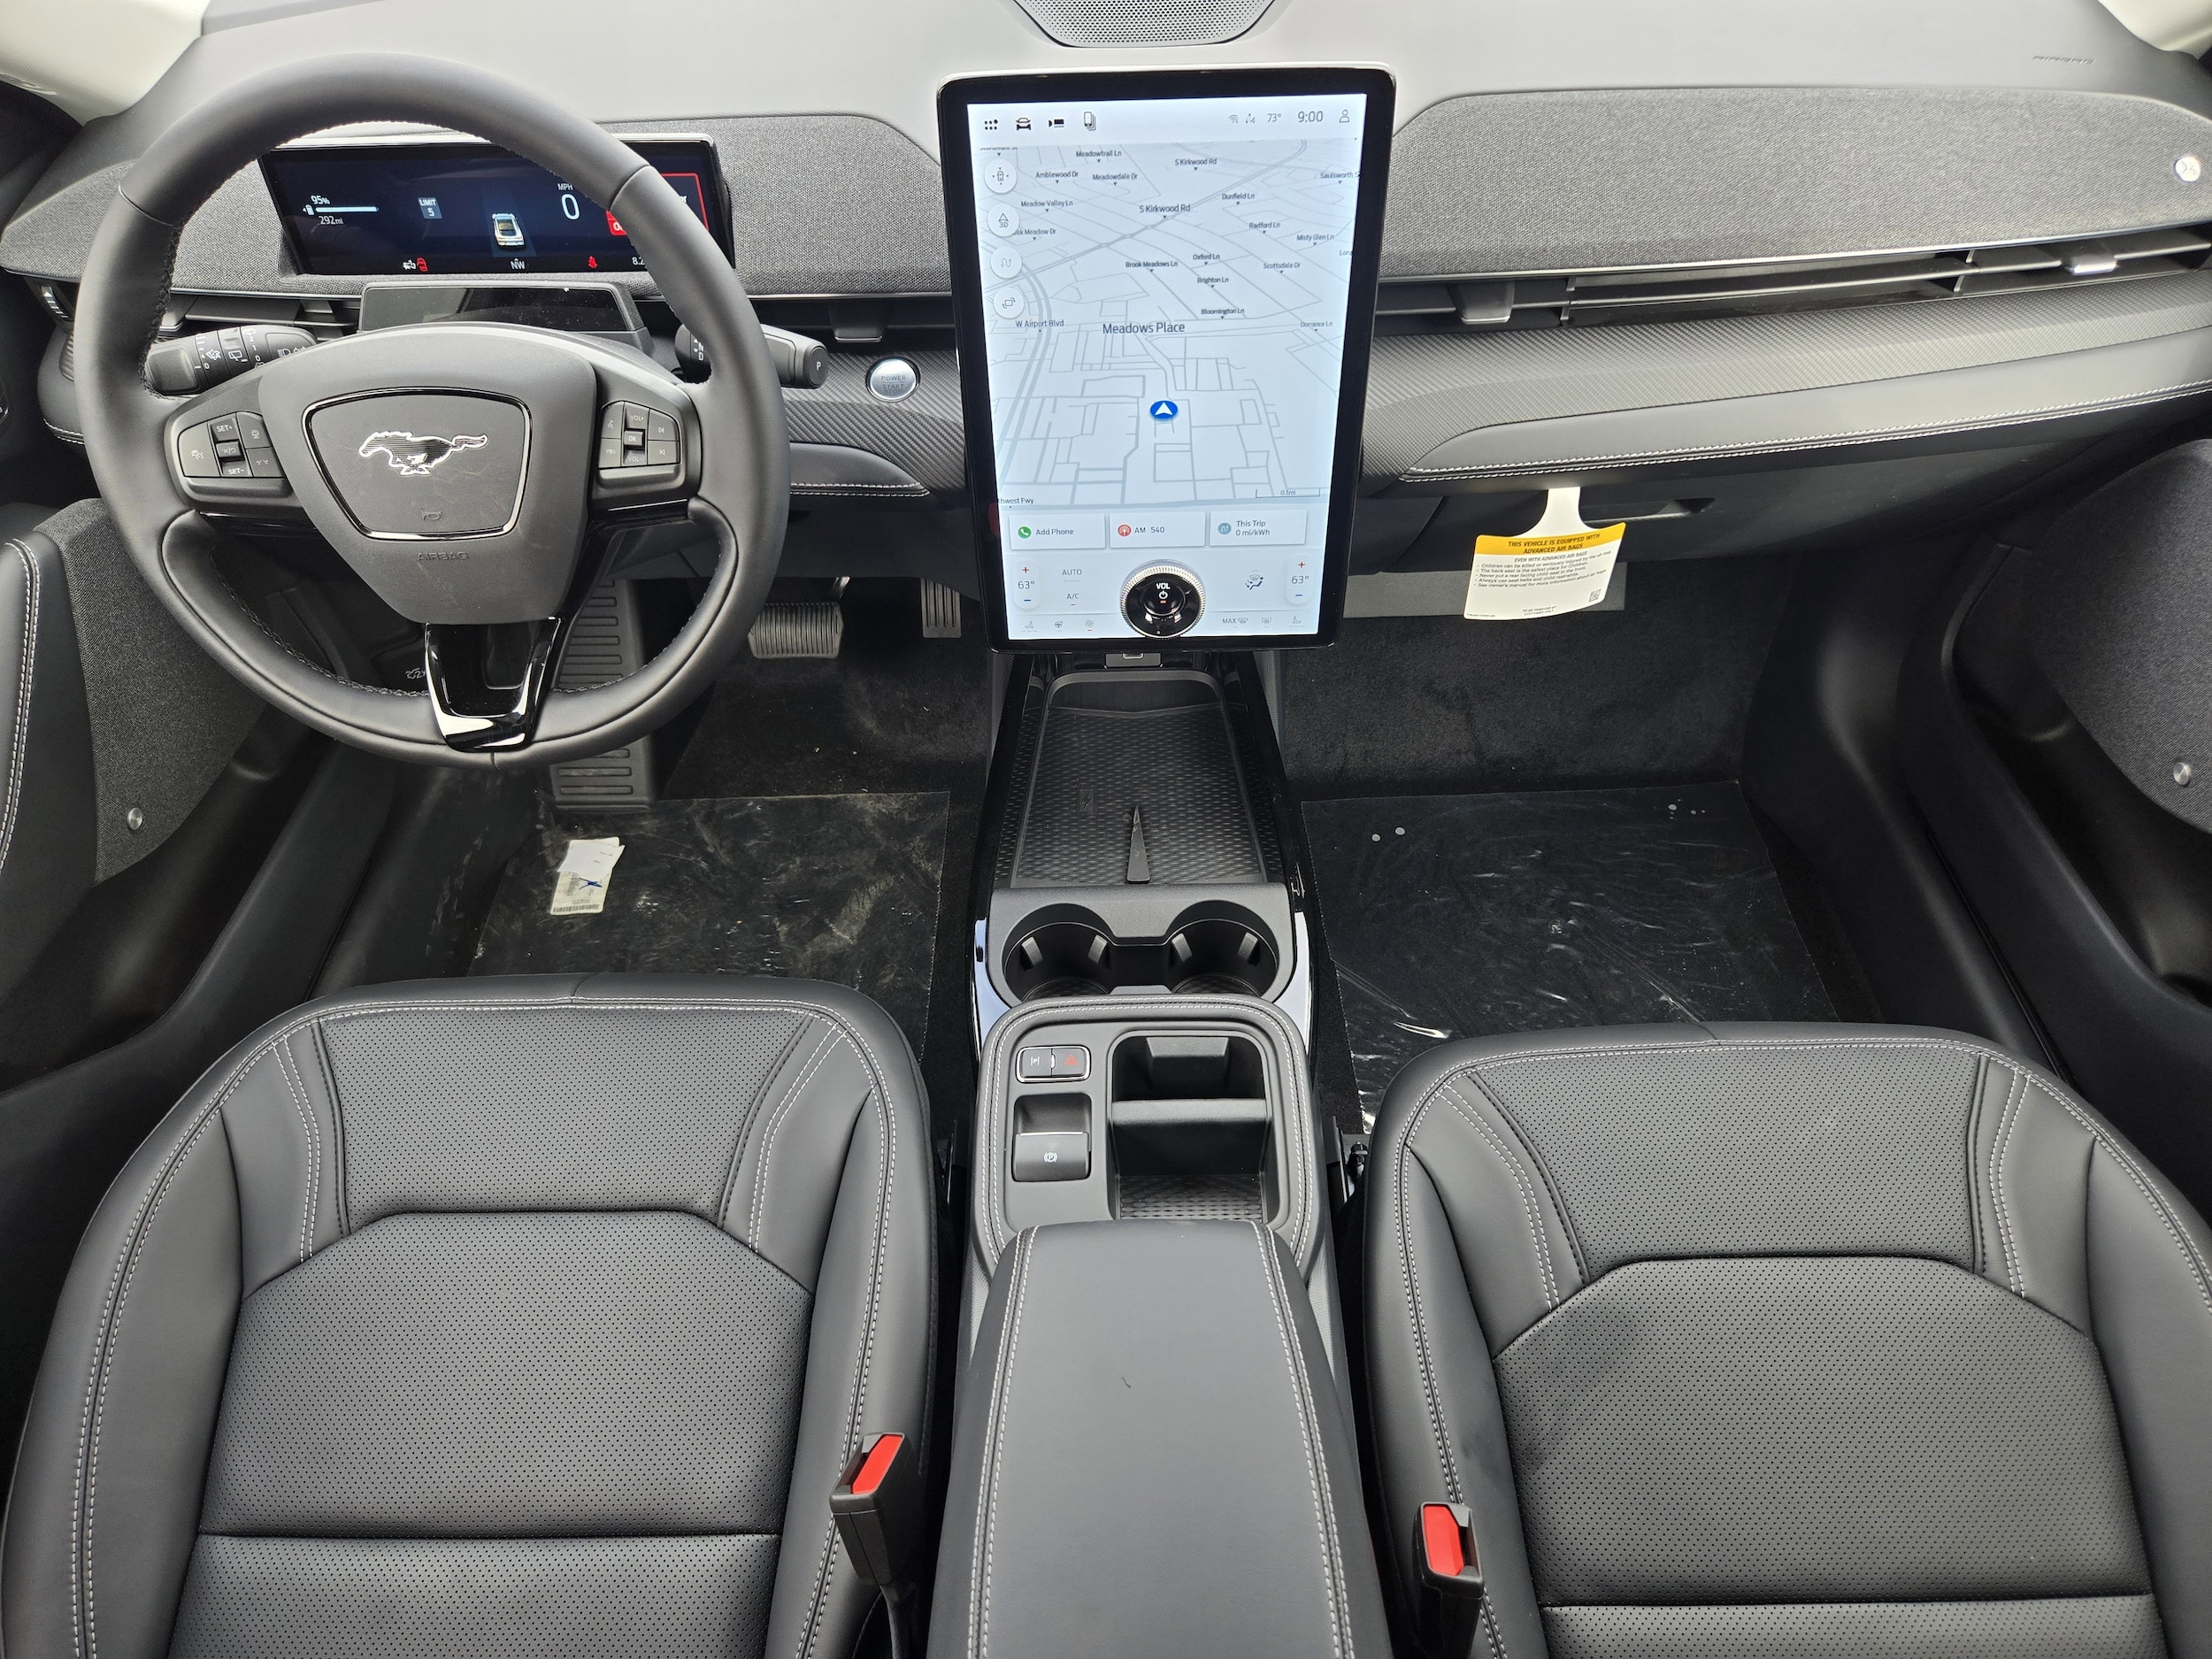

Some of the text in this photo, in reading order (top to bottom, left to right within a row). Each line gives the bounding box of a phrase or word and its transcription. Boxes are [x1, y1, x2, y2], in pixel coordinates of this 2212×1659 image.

[1267, 112, 1282, 123] 73°
[1297, 111, 1324, 123] 9:00
[311, 195, 331, 205] 95%
[1048, 199, 1065, 208] Valley
[427, 207, 435, 217] 5
[562, 194, 580, 220] 0
[1146, 204, 1179, 213] Kirkwood
[511, 260, 526, 270] NW
[1103, 322, 1186, 334] Meadows Place
[698, 352, 704, 361] D
[817, 361, 822, 371] P
[1556, 536, 1585, 545] EQUIPPED
[418, 551, 469, 561] AIRBAG
[1291, 574, 1310, 585] 63°
[1018, 580, 1035, 590] 63°
